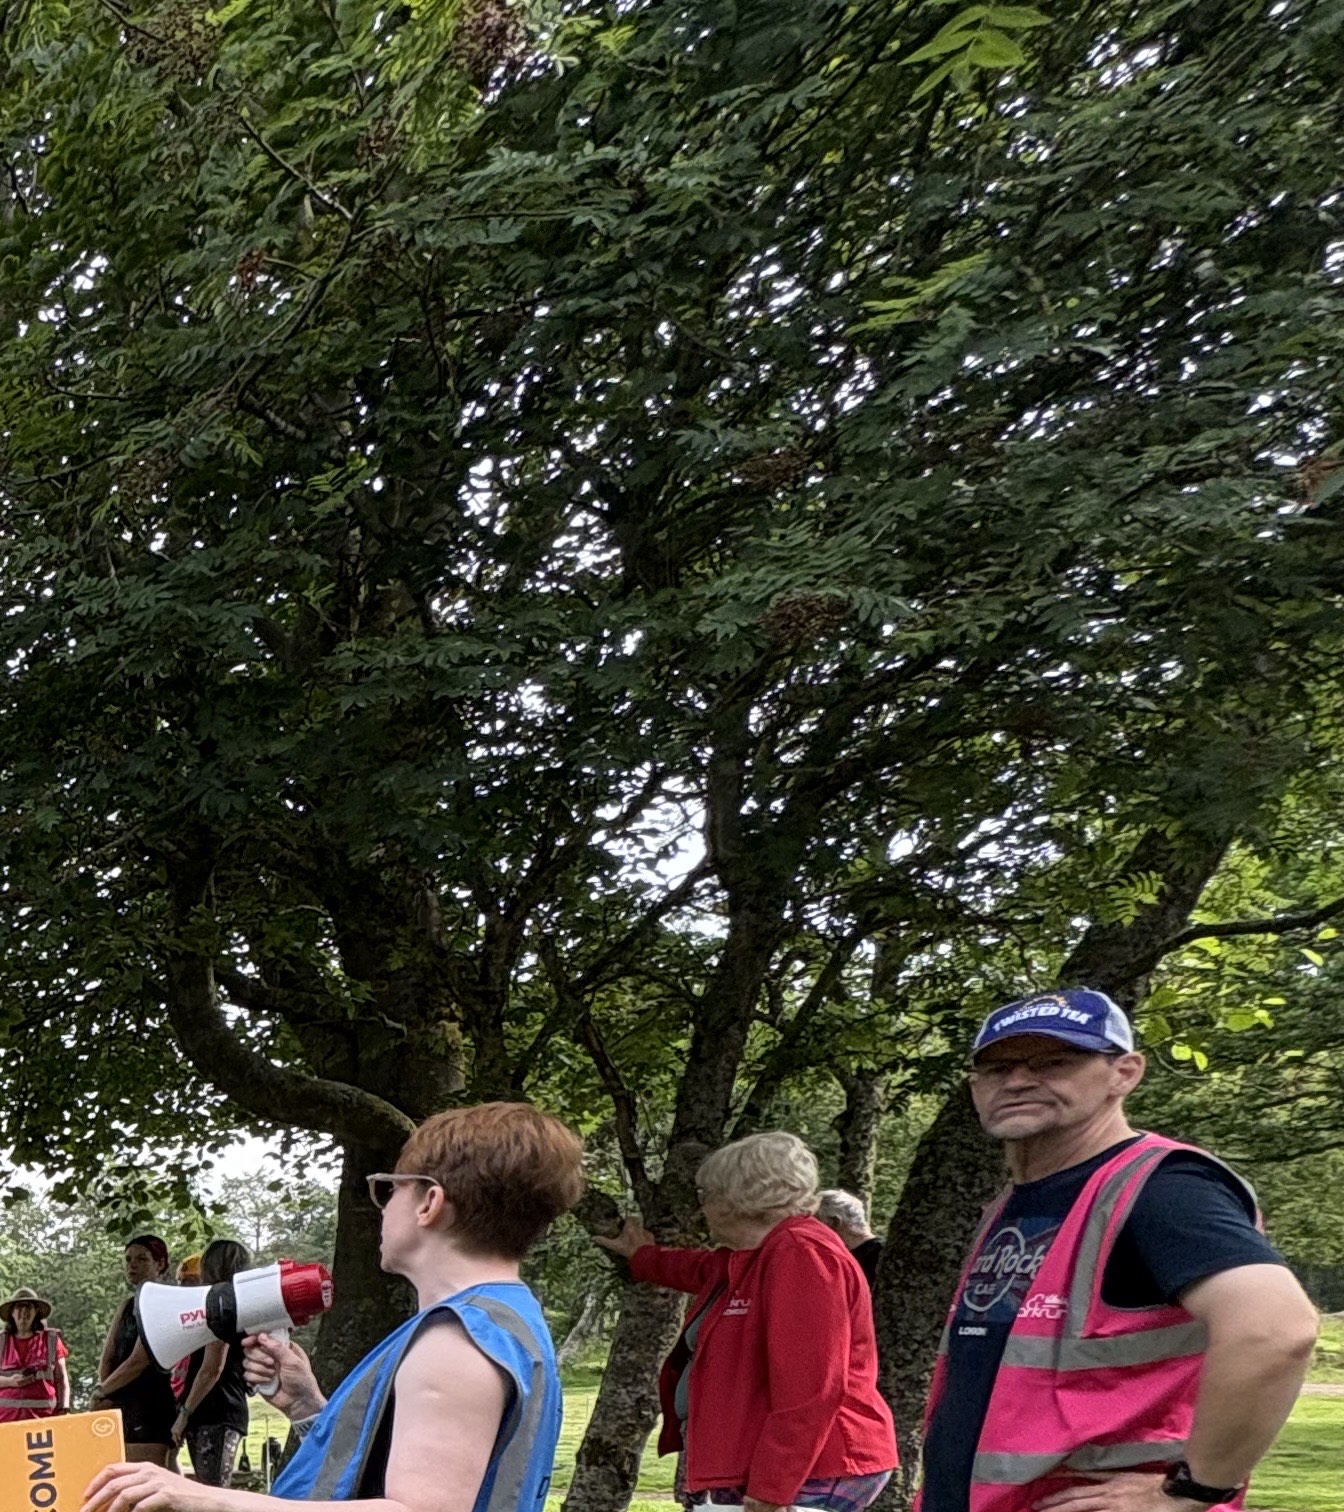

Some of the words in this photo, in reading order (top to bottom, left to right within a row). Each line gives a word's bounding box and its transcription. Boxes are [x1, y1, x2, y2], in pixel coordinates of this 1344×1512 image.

[993, 1007, 1060, 1032] TWISTED
[1060, 1006, 1093, 1025] TEA
[180, 1309, 206, 1325] PYL
